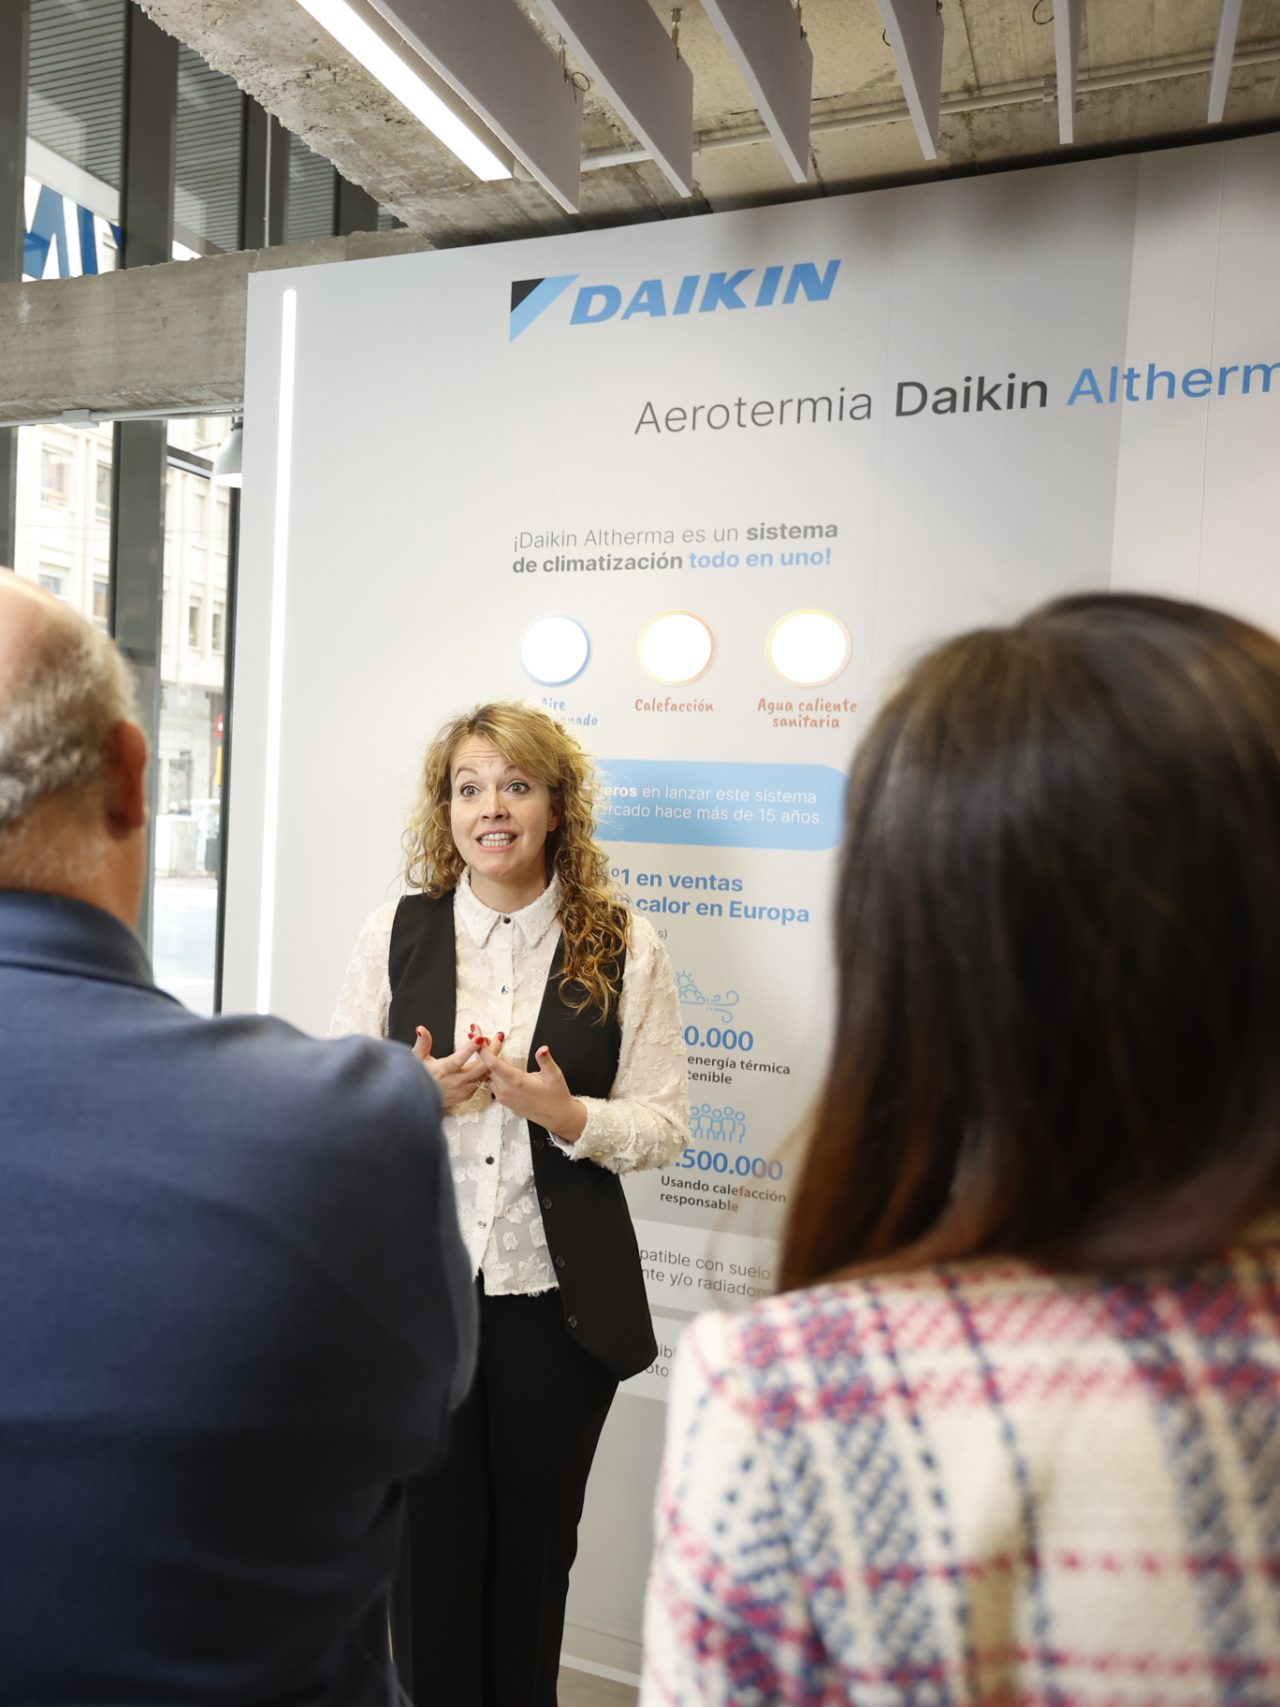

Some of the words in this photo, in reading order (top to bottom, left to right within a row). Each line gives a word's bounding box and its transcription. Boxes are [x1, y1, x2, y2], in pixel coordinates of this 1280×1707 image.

[568, 258, 842, 326] DAIKIN
[633, 385, 873, 436] Aerotermia
[894, 371, 1049, 418] Daikin
[1066, 362, 1280, 406] Altherm
[513, 531, 578, 552] ¡Daikin
[583, 526, 675, 548] Altherma
[681, 528, 706, 544] es
[713, 527, 739, 543] un
[746, 522, 839, 542] sistema
[512, 555, 538, 574] de
[542, 551, 683, 573] climatización
[689, 550, 740, 569] todo
[746, 551, 774, 567] en
[780, 546, 832, 567] uno!
[634, 697, 714, 713] Calefacción
[757, 698, 793, 718] Agua
[798, 696, 858, 713] caliente
[772, 713, 840, 729] sanitaria
[604, 785, 638, 798] eros
[641, 786, 661, 799] en
[665, 785, 711, 801] lanzar
[716, 788, 750, 802] este
[755, 788, 817, 805] sistema
[600, 802, 651, 817] ercado
[655, 804, 692, 819] hace
[696, 805, 728, 821] más
[733, 806, 754, 822] de
[759, 808, 776, 823] 15
[781, 808, 825, 825] años.
[611, 867, 630, 885] º1
[636, 873, 663, 887] en
[669, 874, 743, 892] ventas
[636, 896, 691, 914] calor
[696, 902, 723, 917] en
[728, 900, 810, 926] Europa
[683, 1025, 754, 1051] 0.000
[687, 1055, 737, 1070] energía
[740, 1060, 791, 1075] térmica
[688, 1070, 733, 1085] enible
[675, 1148, 784, 1181] .500.000
[660, 1192, 739, 1212] responsable
[661, 1175, 710, 1192] Usando
[712, 1183, 787, 1203] calefacción
[640, 1249, 691, 1267] patible
[695, 1258, 724, 1272] con
[729, 1263, 772, 1280] suelo
[670, 1271, 693, 1287] y/o
[697, 1278, 772, 1297] radiadore
